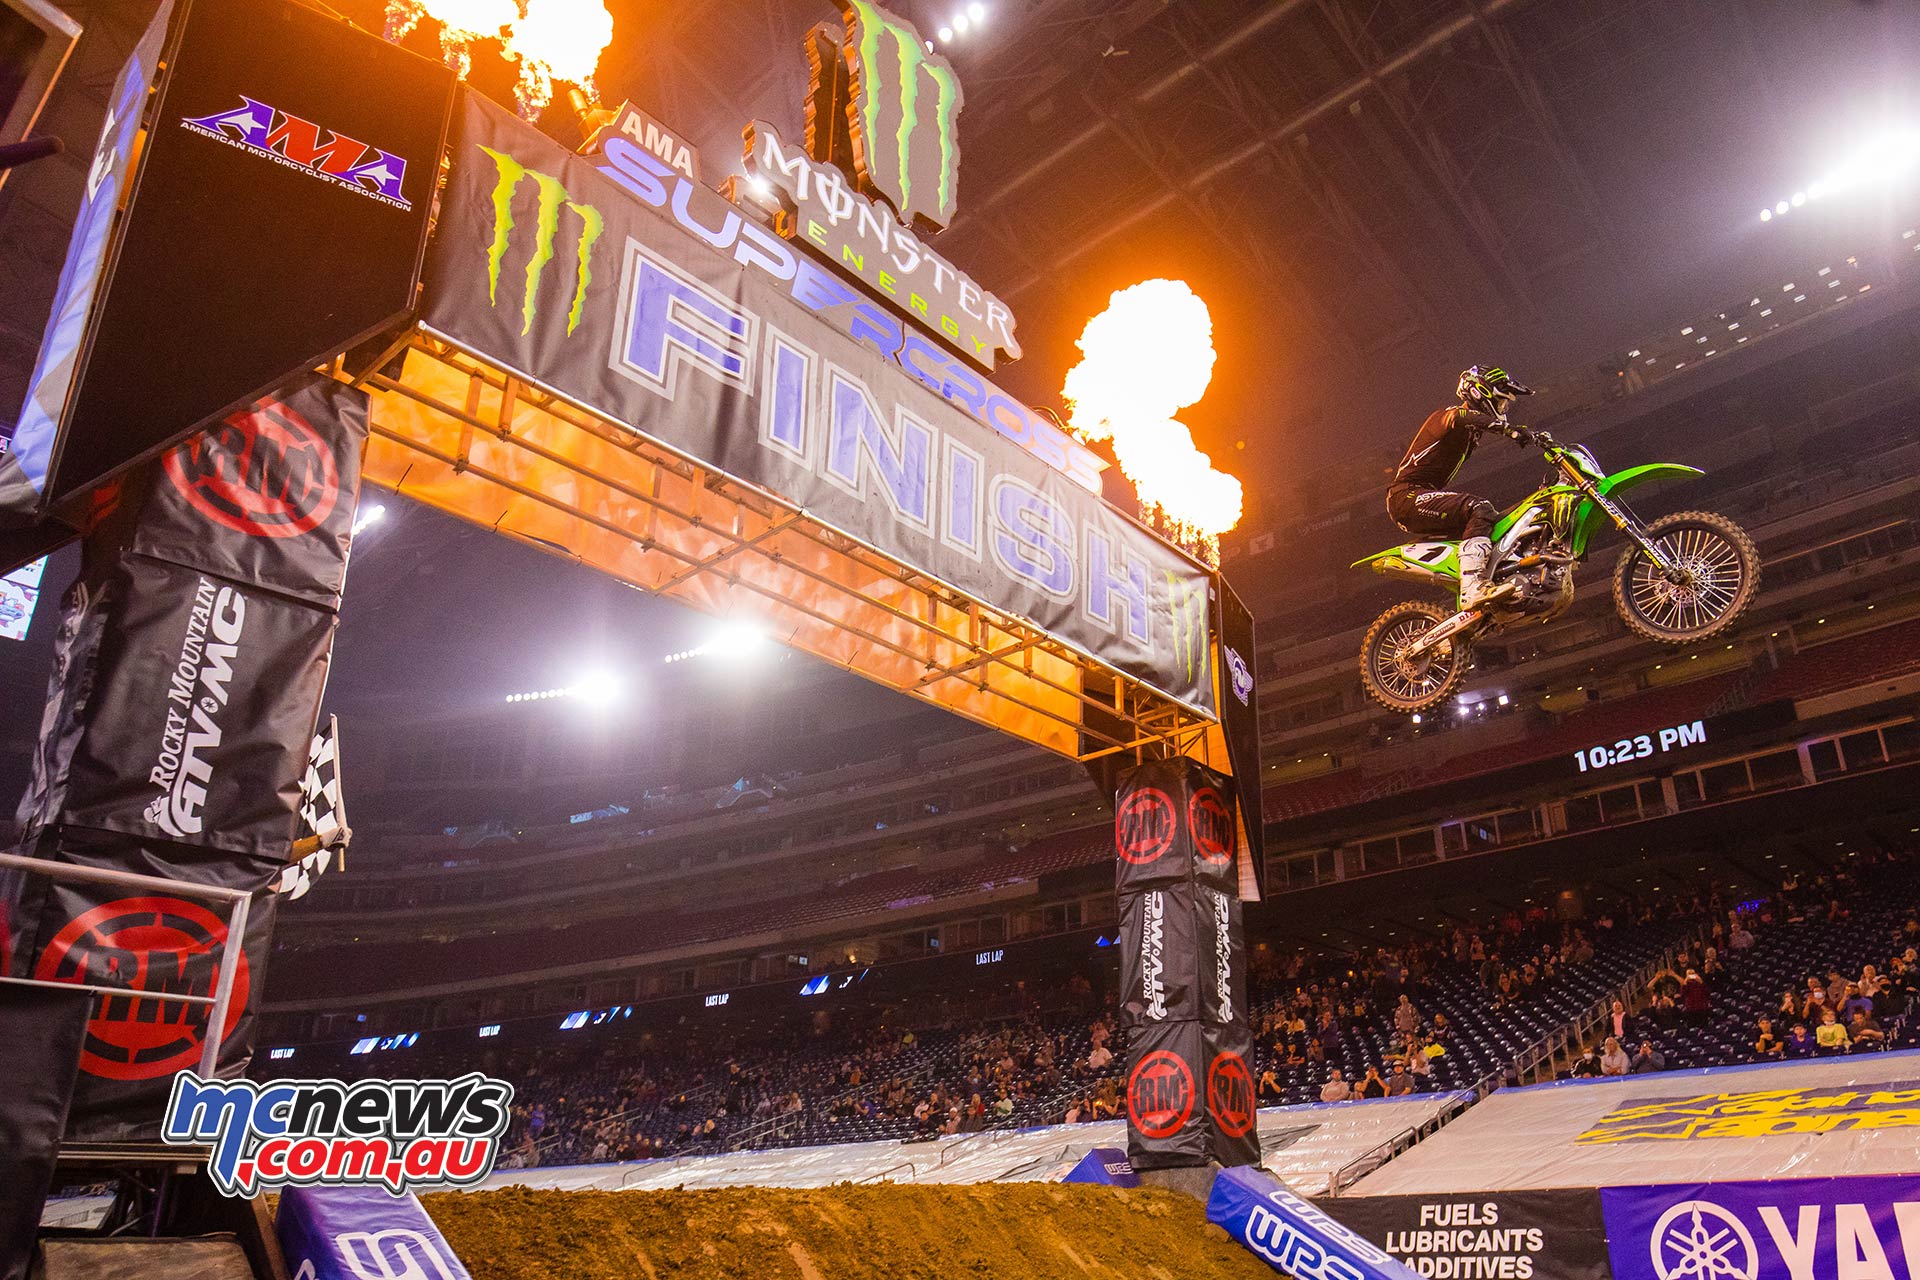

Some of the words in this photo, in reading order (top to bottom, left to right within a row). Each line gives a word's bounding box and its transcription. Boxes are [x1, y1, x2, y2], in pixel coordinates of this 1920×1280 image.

[180, 121, 246, 151] AMERICAN
[247, 146, 338, 184] MOTORCYCLIST
[339, 180, 412, 212] ASSOCIATION
[182, 94, 411, 204] AMA
[620, 111, 694, 178] AMA
[595, 137, 1104, 493] SUPERCROSS
[808, 219, 986, 354] ENERGY
[609, 236, 1155, 655] FINISH
[149, 707, 187, 792] ROCKY
[168, 577, 217, 709] MOUNTAIN
[1574, 735, 1654, 772] 10:23
[1659, 720, 1707, 752] PM
[1141, 893, 1152, 958] MOUNTAIN
[975, 951, 990, 965] LAST
[991, 949, 1003, 962] LAP
[1142, 959, 1153, 1000] ROCKY
[705, 995, 717, 1006] LAST
[718, 993, 729, 1005] LAP
[270, 1048, 282, 1059] LAST
[283, 1047, 294, 1058] LAP
[479, 1025, 490, 1037] LAST
[490, 1024, 500, 1036] LAP
[1386, 1228, 1544, 1253] LUBRICANTS
[1420, 1202, 1499, 1227] FUELS
